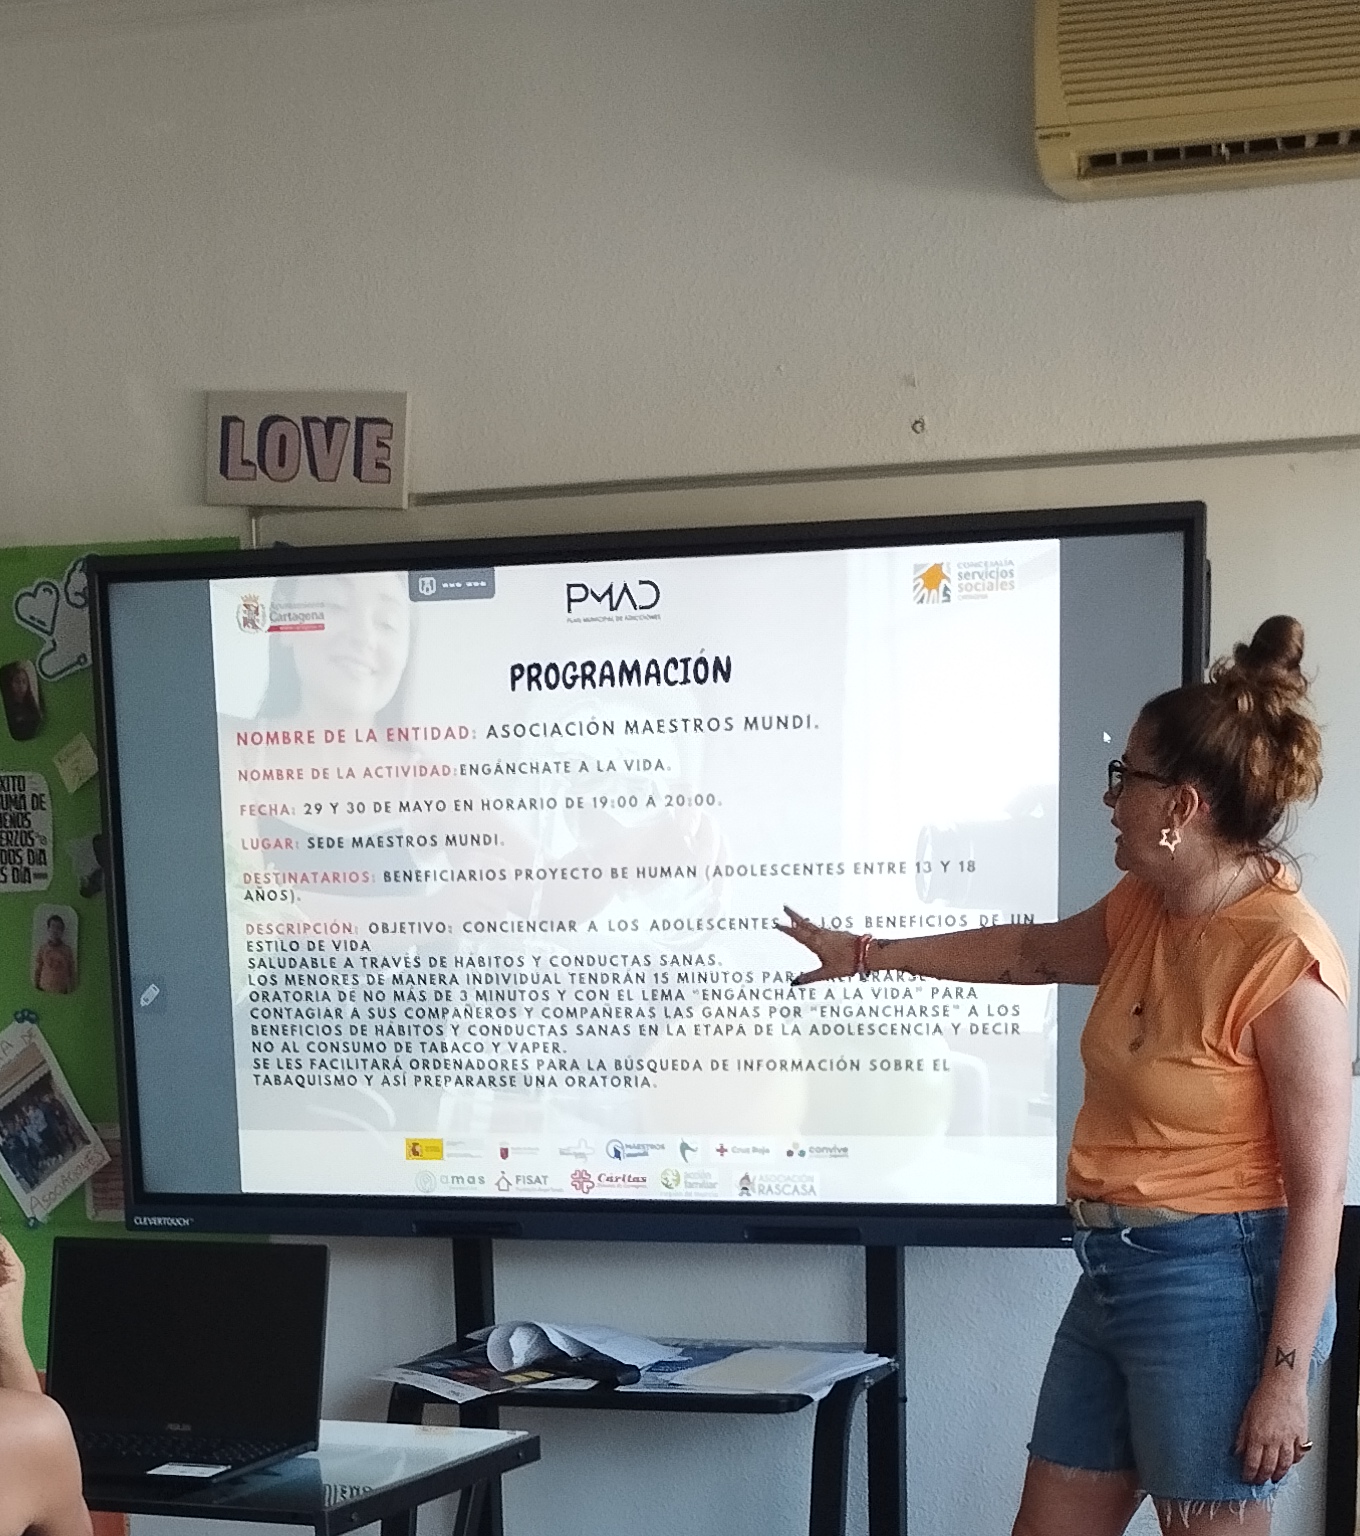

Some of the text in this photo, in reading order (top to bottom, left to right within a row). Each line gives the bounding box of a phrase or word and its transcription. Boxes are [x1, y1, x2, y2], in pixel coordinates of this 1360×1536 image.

[220, 414, 393, 484] LOVE
[509, 649, 733, 692] PROGRAMACIÓN
[235, 713, 819, 747] NOMBRE DE LA ENTIDAD: ASOCIACIÓN MAESTROS MUNDI.
[237, 757, 672, 782] NOMBRE DE LA ACTIVIDAD:ENGÁNCHATE A LA VIDA.
[31, 793, 47, 811] DE
[238, 792, 723, 817] FECHA: 29 Y 30 DE MAYO EN HORARIO DE 19:00 A 20:00.
[240, 832, 505, 851] LUGAR: SEDE MAESTROS MUNDI.
[242, 859, 976, 885] DESTINATARIOS: BENEFICIARIOS PROYECTO BE HUMAN (ADOLESCENTES ENTRE 13 Y 18
[242, 885, 302, 904] AÑOS).
[244, 919, 359, 936] DESCRIPCIÓN:
[367, 921, 453, 934] OBJETIVO:
[461, 919, 577, 933] CONCIENCIAR
[586, 919, 599, 931] A
[607, 919, 639, 931] LOS
[647, 917, 780, 931] ADOLESCENTES
[863, 914, 969, 928] BENEFICIOS
[978, 914, 1000, 925] DE
[245, 939, 371, 952] ESTILO DE VIDA
[246, 952, 723, 969] SALUDABLE A TRAVÉS DE HÁBITOS Y CONDUCTAS SANAS.
[247, 985, 979, 1003] ORATORIA DE NO MÁS DE 3 MINUTOS Y CON EL LEMA "ENGÁNCHATE A LA VIDA" PARA
[250, 1041, 568, 1053] NO AL CONSUMO DE TABACO Y VAPER.
[251, 1056, 951, 1073] SE LES FACILITARÁ ORDENADORES PARA LA BÚSQUEDA DE INFORMACIÓN SOBRE EL
[253, 1072, 658, 1089] TABAQUISMO Y ASÍ PREPARARSE UNA ORATORIA.
[515, 1174, 549, 1186] FISAT
[757, 1183, 817, 1197] RASCASA
[133, 1215, 190, 1227] CLEVERTOUCH
